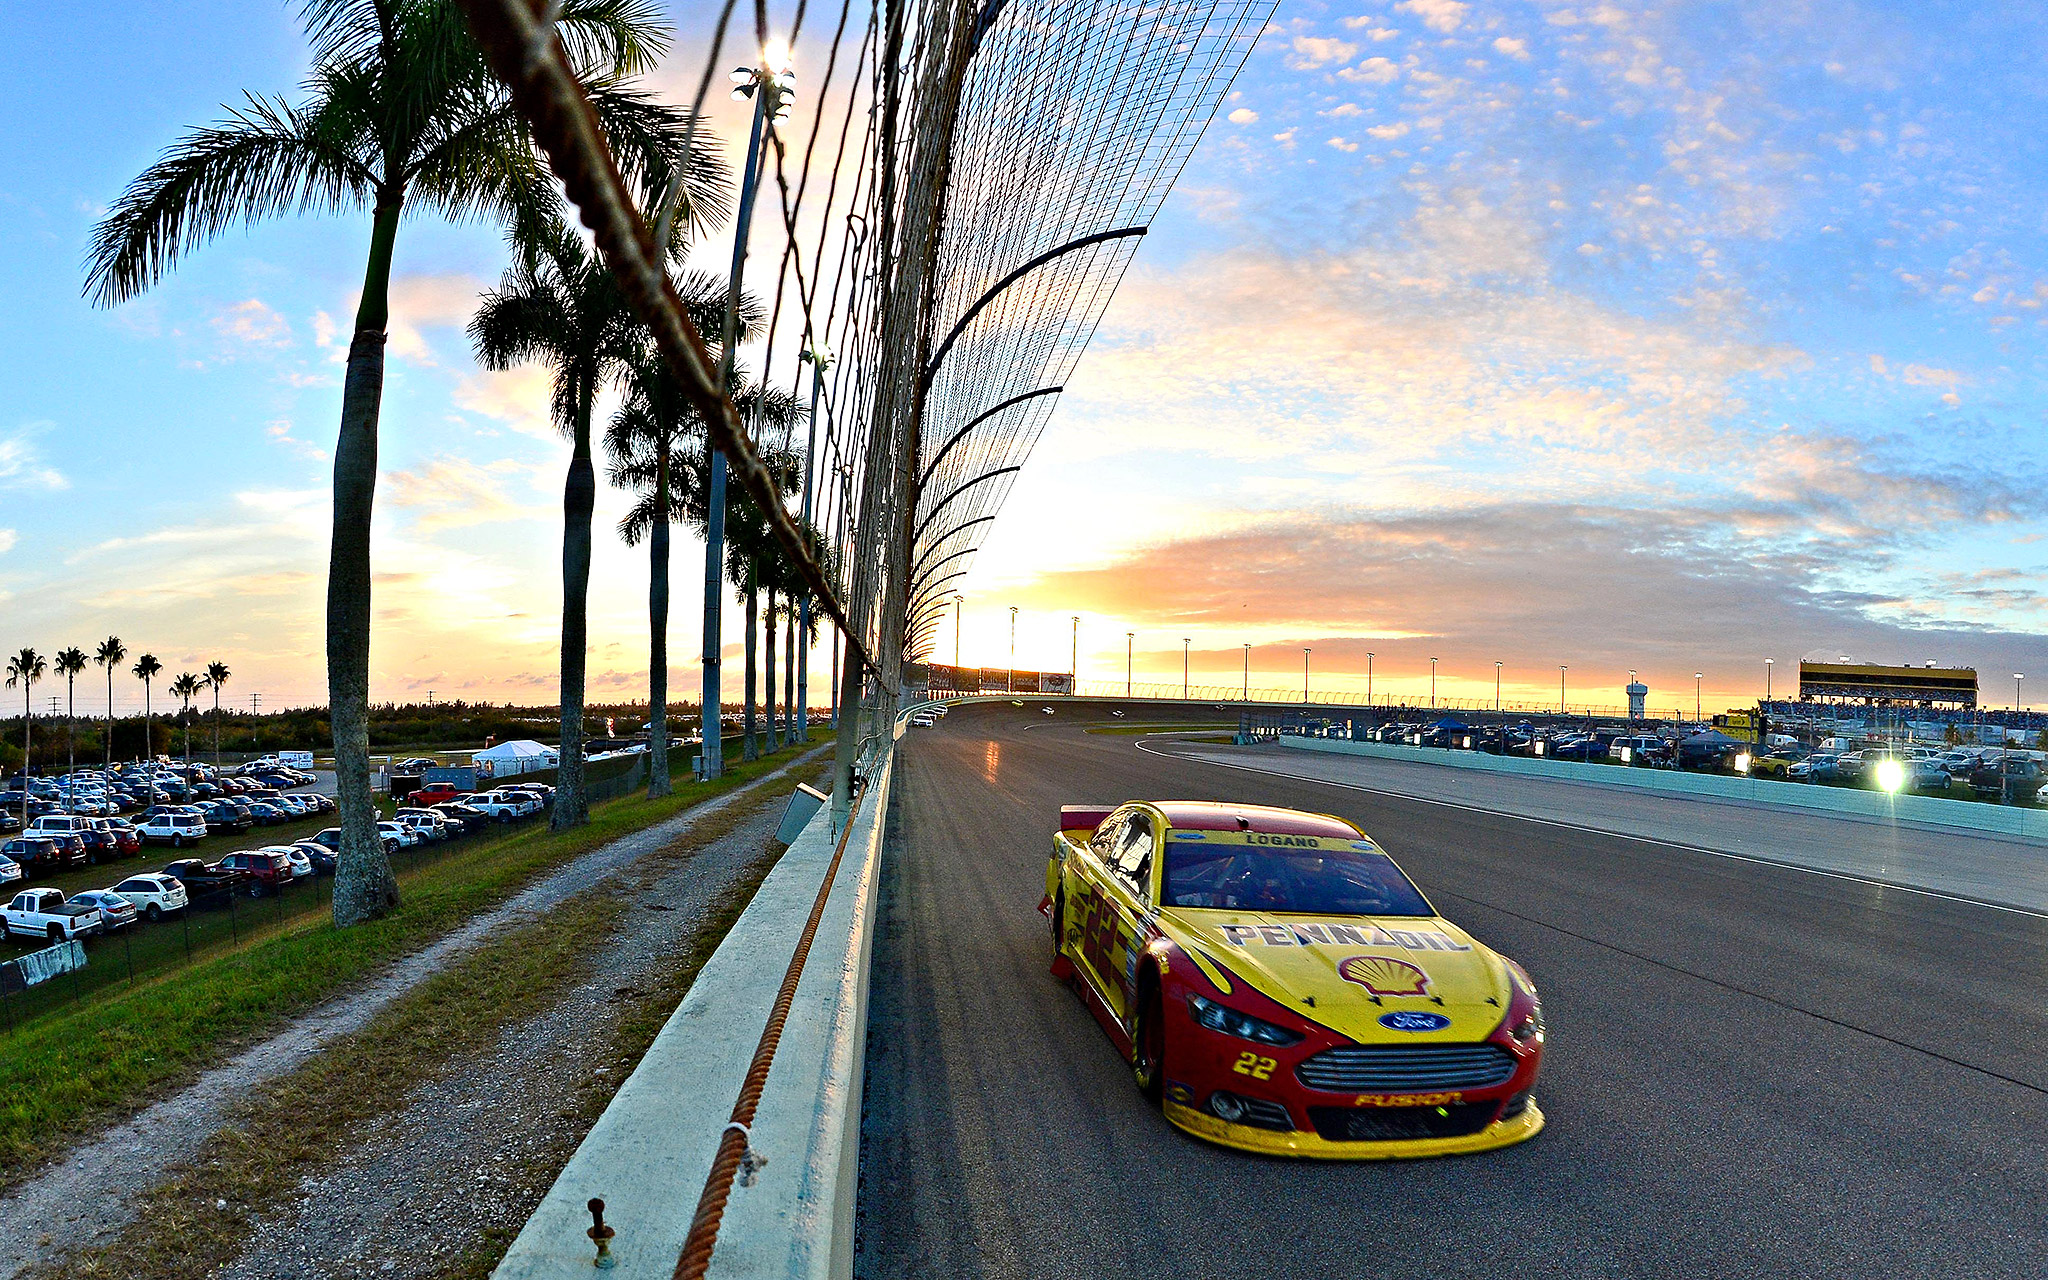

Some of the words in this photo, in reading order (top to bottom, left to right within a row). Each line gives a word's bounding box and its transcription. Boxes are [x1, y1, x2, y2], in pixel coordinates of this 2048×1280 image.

[1246, 834, 1319, 848] LOGANO
[1219, 924, 1472, 951] PENNZOIL
[1393, 1012, 1437, 1027] Ford
[1232, 1051, 1278, 1081] 22
